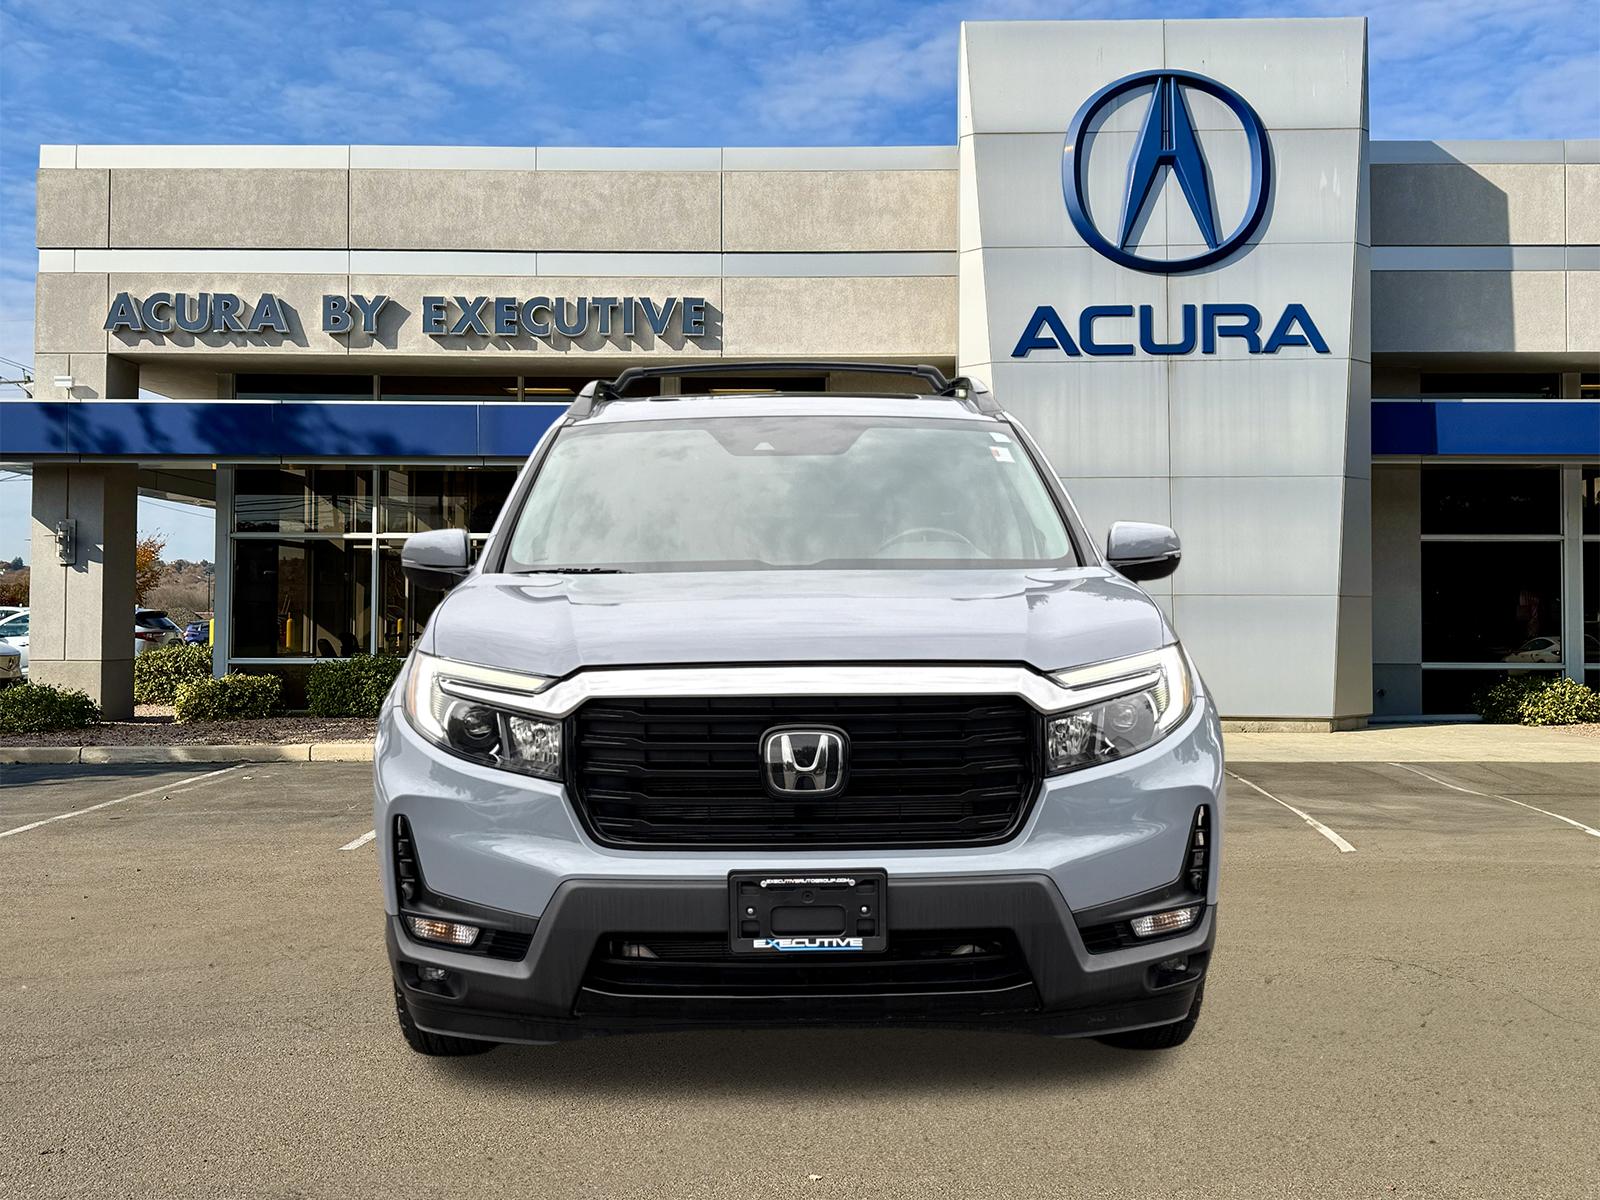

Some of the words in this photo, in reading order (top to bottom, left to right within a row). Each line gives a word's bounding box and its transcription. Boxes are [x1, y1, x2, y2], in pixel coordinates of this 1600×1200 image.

[103, 291, 291, 334] ACURA
[322, 294, 391, 335] BY
[421, 296, 706, 337] EXECUTIVE
[1010, 303, 1333, 358] ACURA
[753, 938, 863, 950] EXECUTIVE
